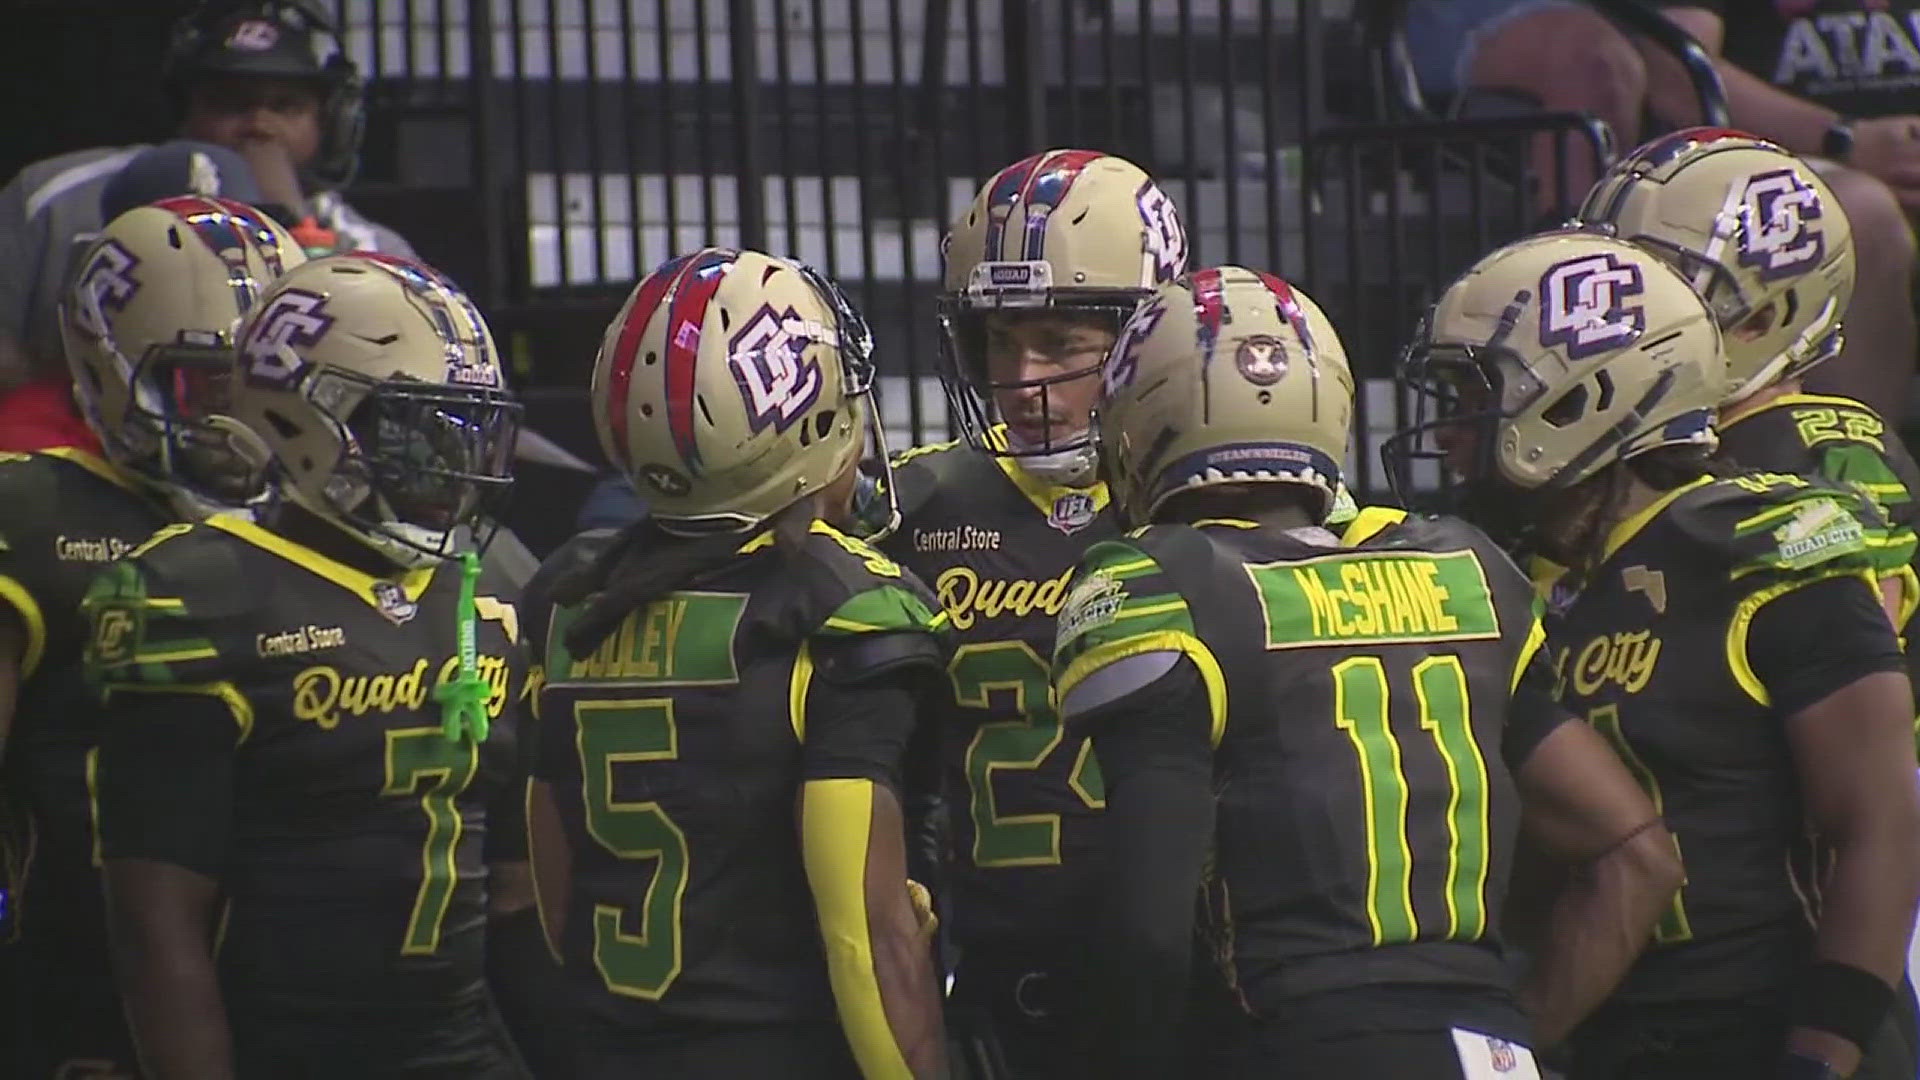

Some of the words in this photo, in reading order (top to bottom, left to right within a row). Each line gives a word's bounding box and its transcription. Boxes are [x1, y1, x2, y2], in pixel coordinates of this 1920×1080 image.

[1773, 10, 1920, 84] ATA
[56, 534, 107, 561] Central
[913, 526, 961, 552] Central
[963, 525, 1001, 550] Store
[935, 564, 1076, 630] Quad
[1292, 560, 1459, 637] McSHANE
[257, 625, 309, 658] Central
[308, 624, 346, 650] Store
[1573, 629, 1662, 697] City
[292, 657, 429, 730] Quad
[1332, 655, 1489, 947] 11
[382, 727, 479, 955] 7
[573, 696, 690, 1001] 5
